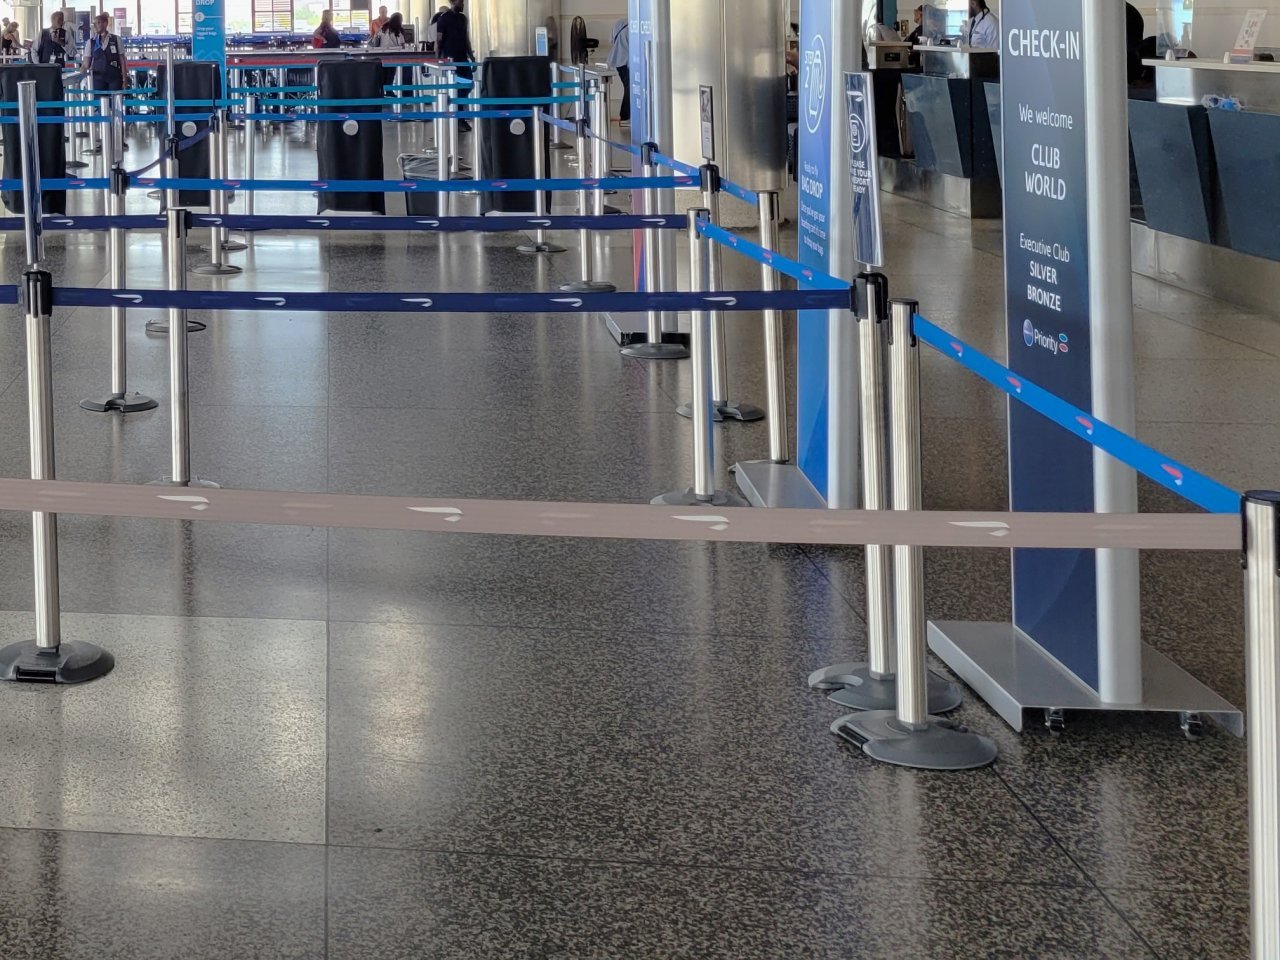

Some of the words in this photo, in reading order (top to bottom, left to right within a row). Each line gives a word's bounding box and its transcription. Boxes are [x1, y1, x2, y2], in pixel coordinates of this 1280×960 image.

[1009, 28, 1080, 60] CHECK-IN
[804, 67, 809, 88] 2
[1019, 103, 1033, 123] We
[1035, 106, 1073, 130] welcome
[1031, 143, 1060, 169] CLUB
[810, 179, 824, 199] DROP
[1025, 171, 1066, 201] WORLD
[1020, 233, 1051, 257] Executive
[1053, 243, 1070, 262] Club
[1030, 260, 1058, 285] SILVER
[1027, 284, 1061, 311] BRONZE
[1034, 329, 1058, 355] Priority
